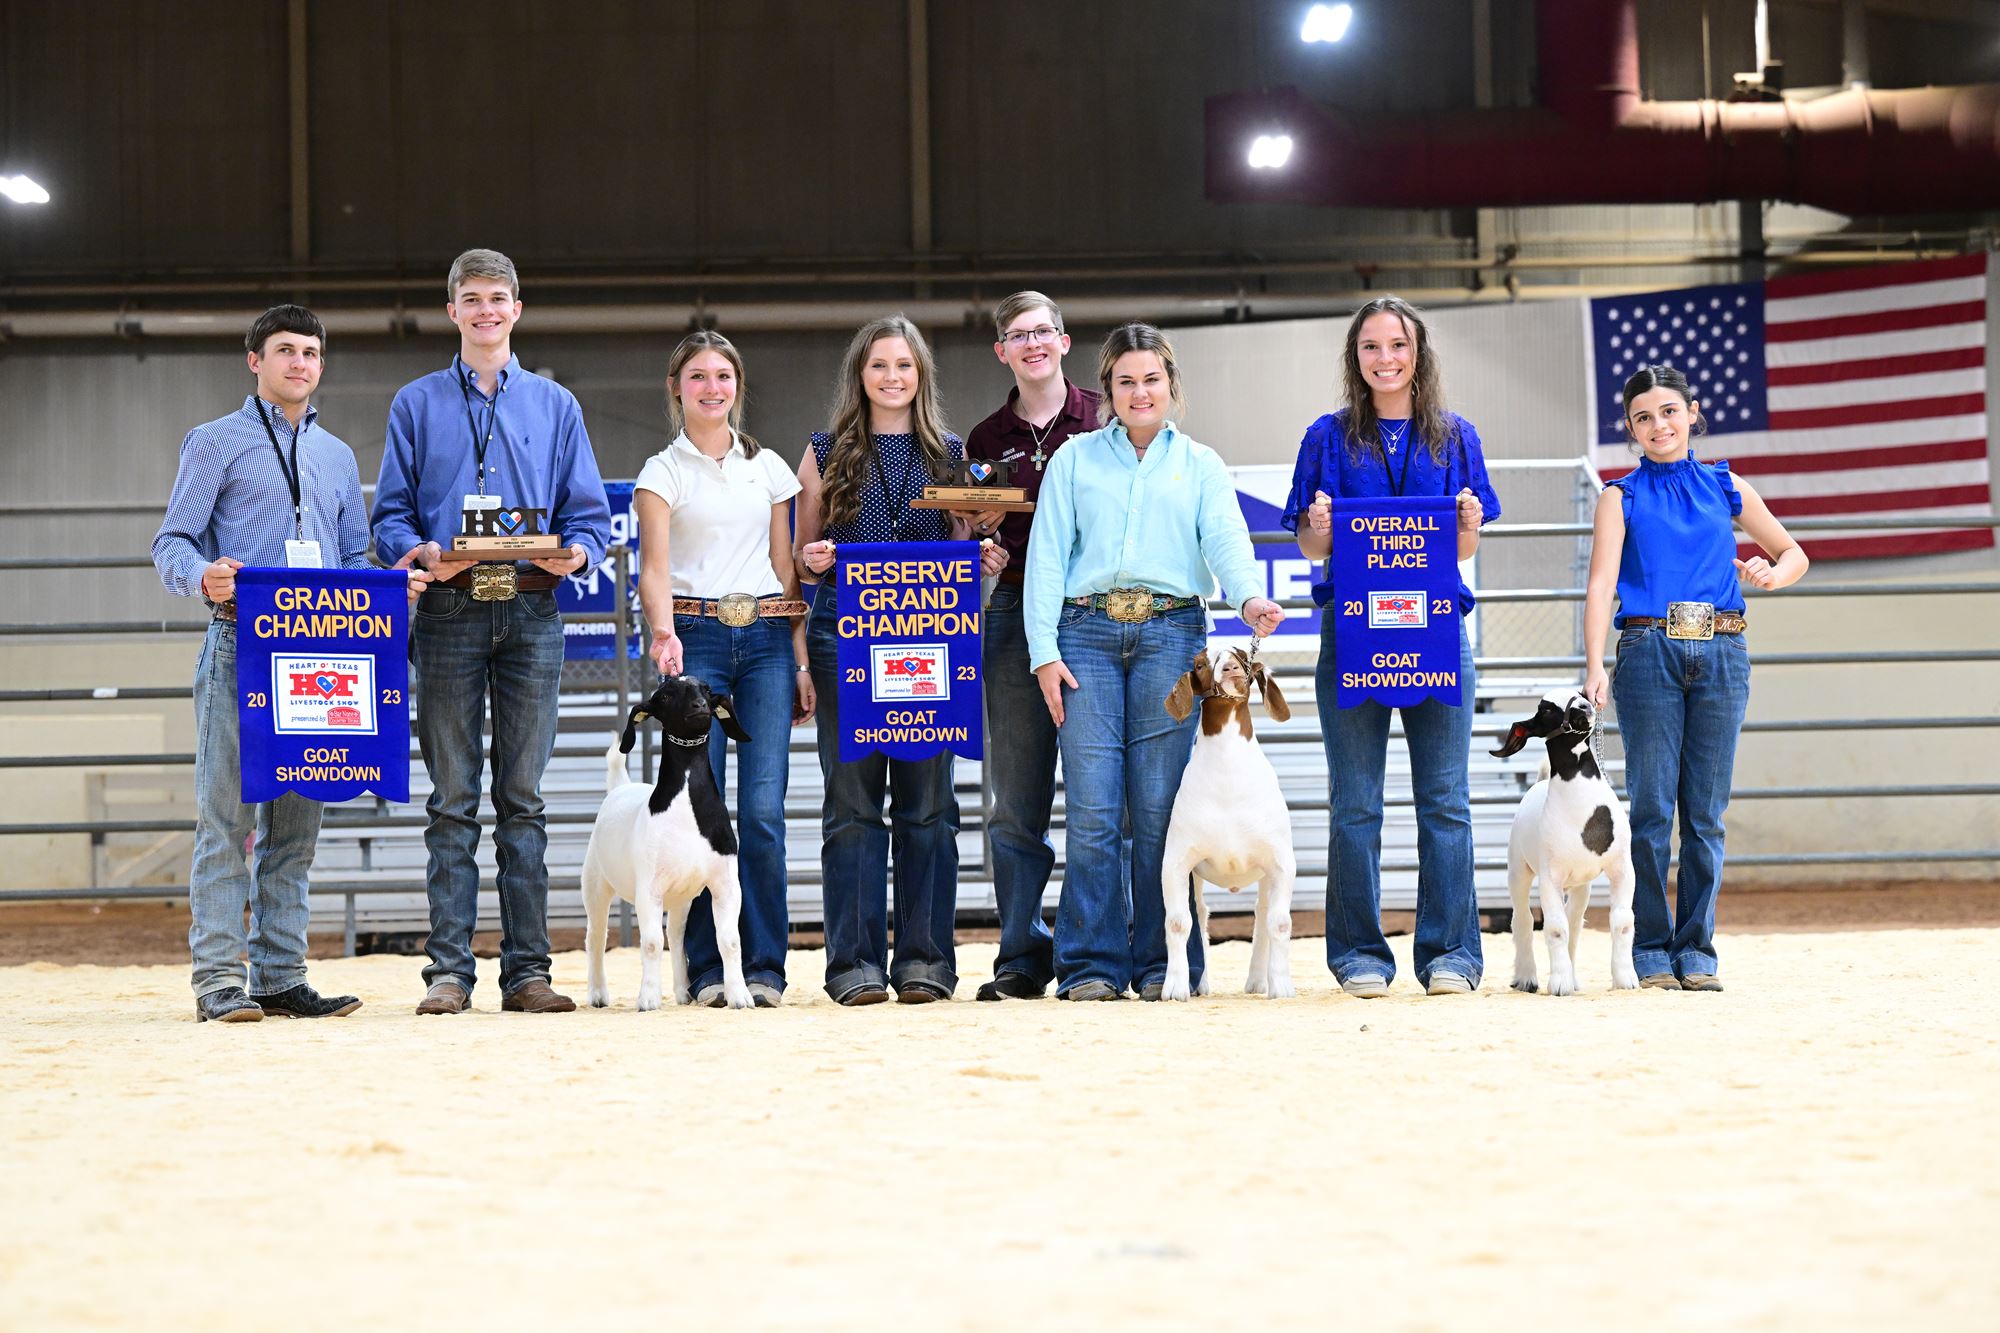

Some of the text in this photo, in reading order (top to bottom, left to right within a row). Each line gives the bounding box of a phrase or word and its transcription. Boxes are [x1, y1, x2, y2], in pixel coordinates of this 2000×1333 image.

[1351, 516, 1440, 533] OVERALL
[1370, 535, 1425, 551] THIRD
[1367, 553, 1428, 569] PLACE
[846, 560, 973, 585] RESERVE
[274, 587, 371, 612] GRAND
[859, 587, 959, 611] GRAND
[1343, 601, 1364, 616] 20
[1432, 600, 1452, 615] 23
[254, 614, 392, 638] CHAMPION
[837, 612, 979, 638] CHAMPION
[332, 663, 358, 671] TEXAS
[1371, 653, 1421, 668] GOAT
[846, 668, 866, 683] 20
[957, 666, 976, 681] 23
[1342, 671, 1457, 688] SHOWDOWN
[247, 692, 267, 708] 20
[382, 689, 401, 704] 23
[886, 710, 937, 726] GOAT
[854, 727, 968, 743] SHOWDOWN
[303, 748, 350, 763] GOAT
[276, 766, 381, 782] SHOWDOWN
